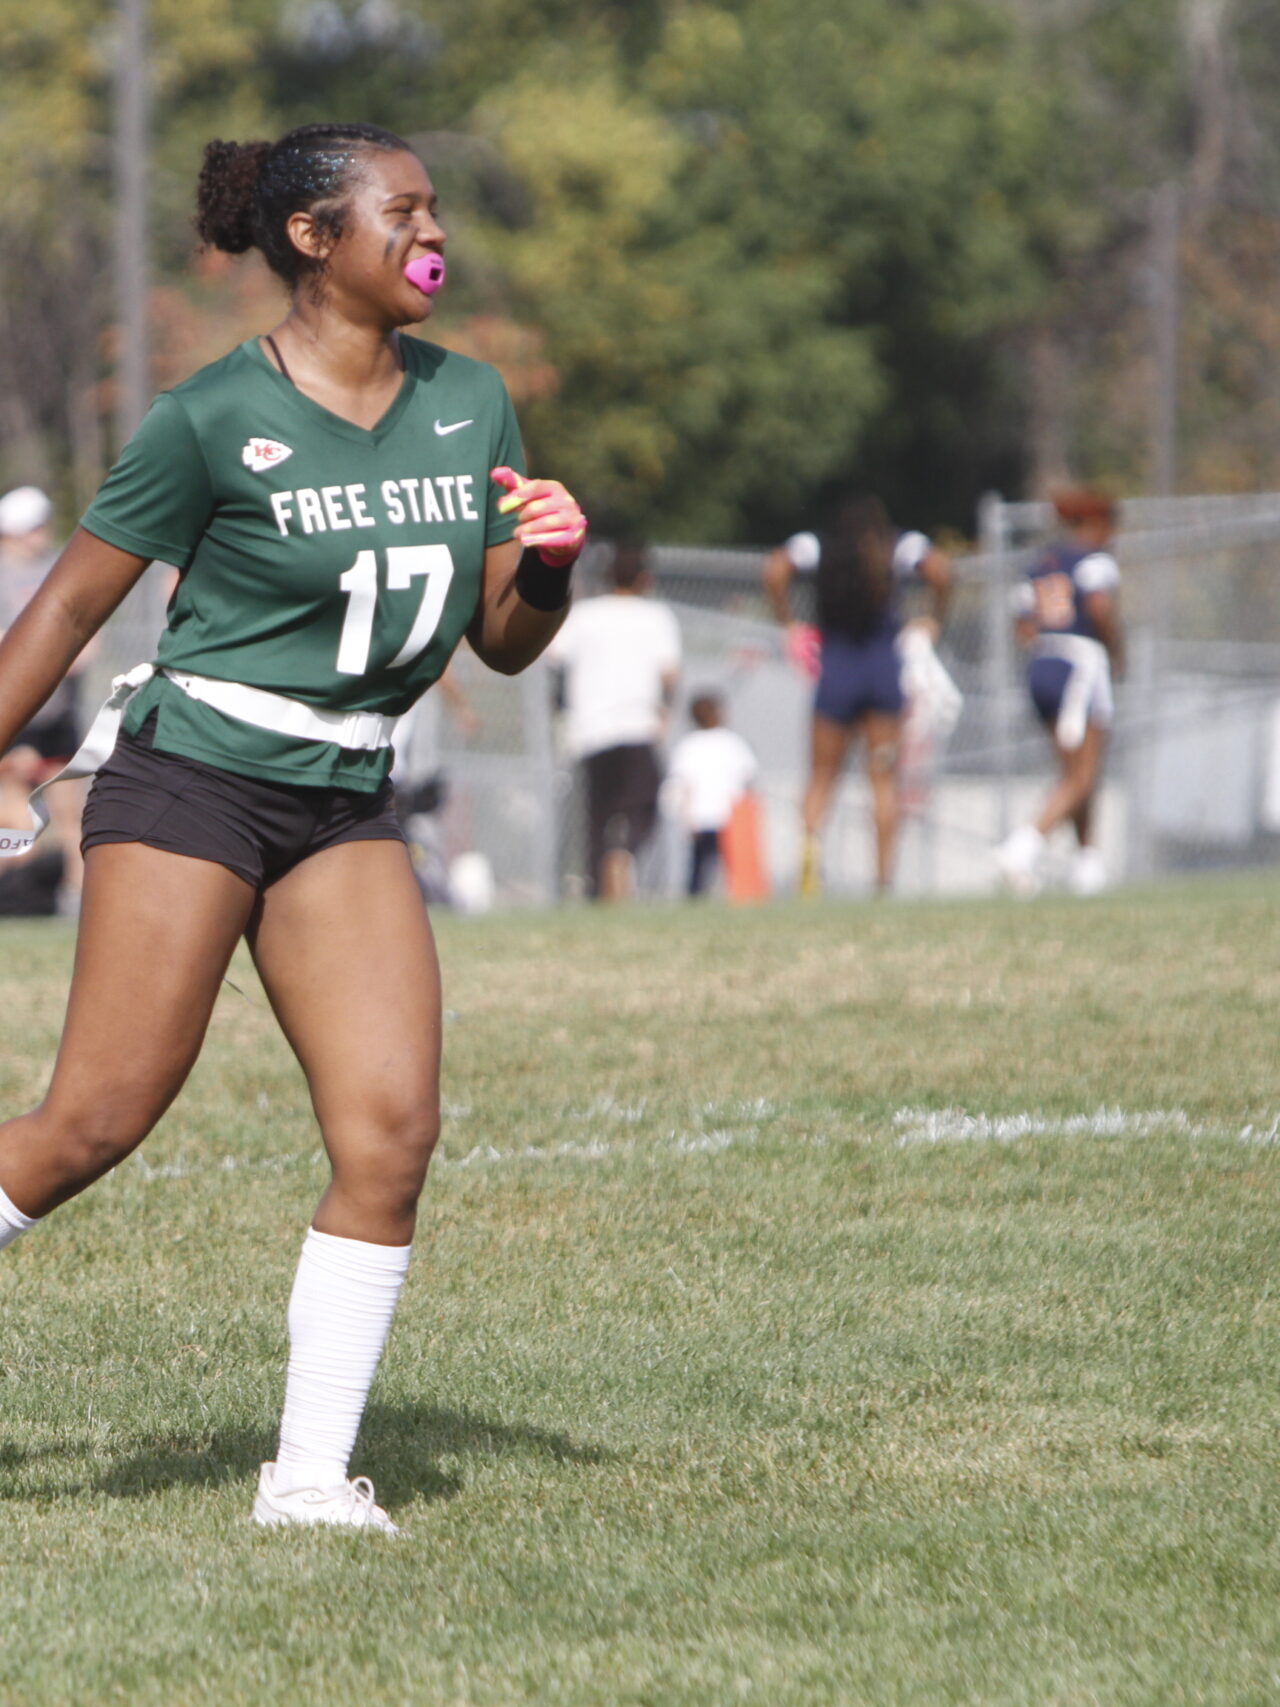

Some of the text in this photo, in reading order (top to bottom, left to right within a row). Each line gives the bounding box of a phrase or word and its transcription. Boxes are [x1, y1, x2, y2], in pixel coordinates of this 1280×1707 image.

[270, 475, 478, 536] FREE STATE
[336, 544, 455, 675] 17
